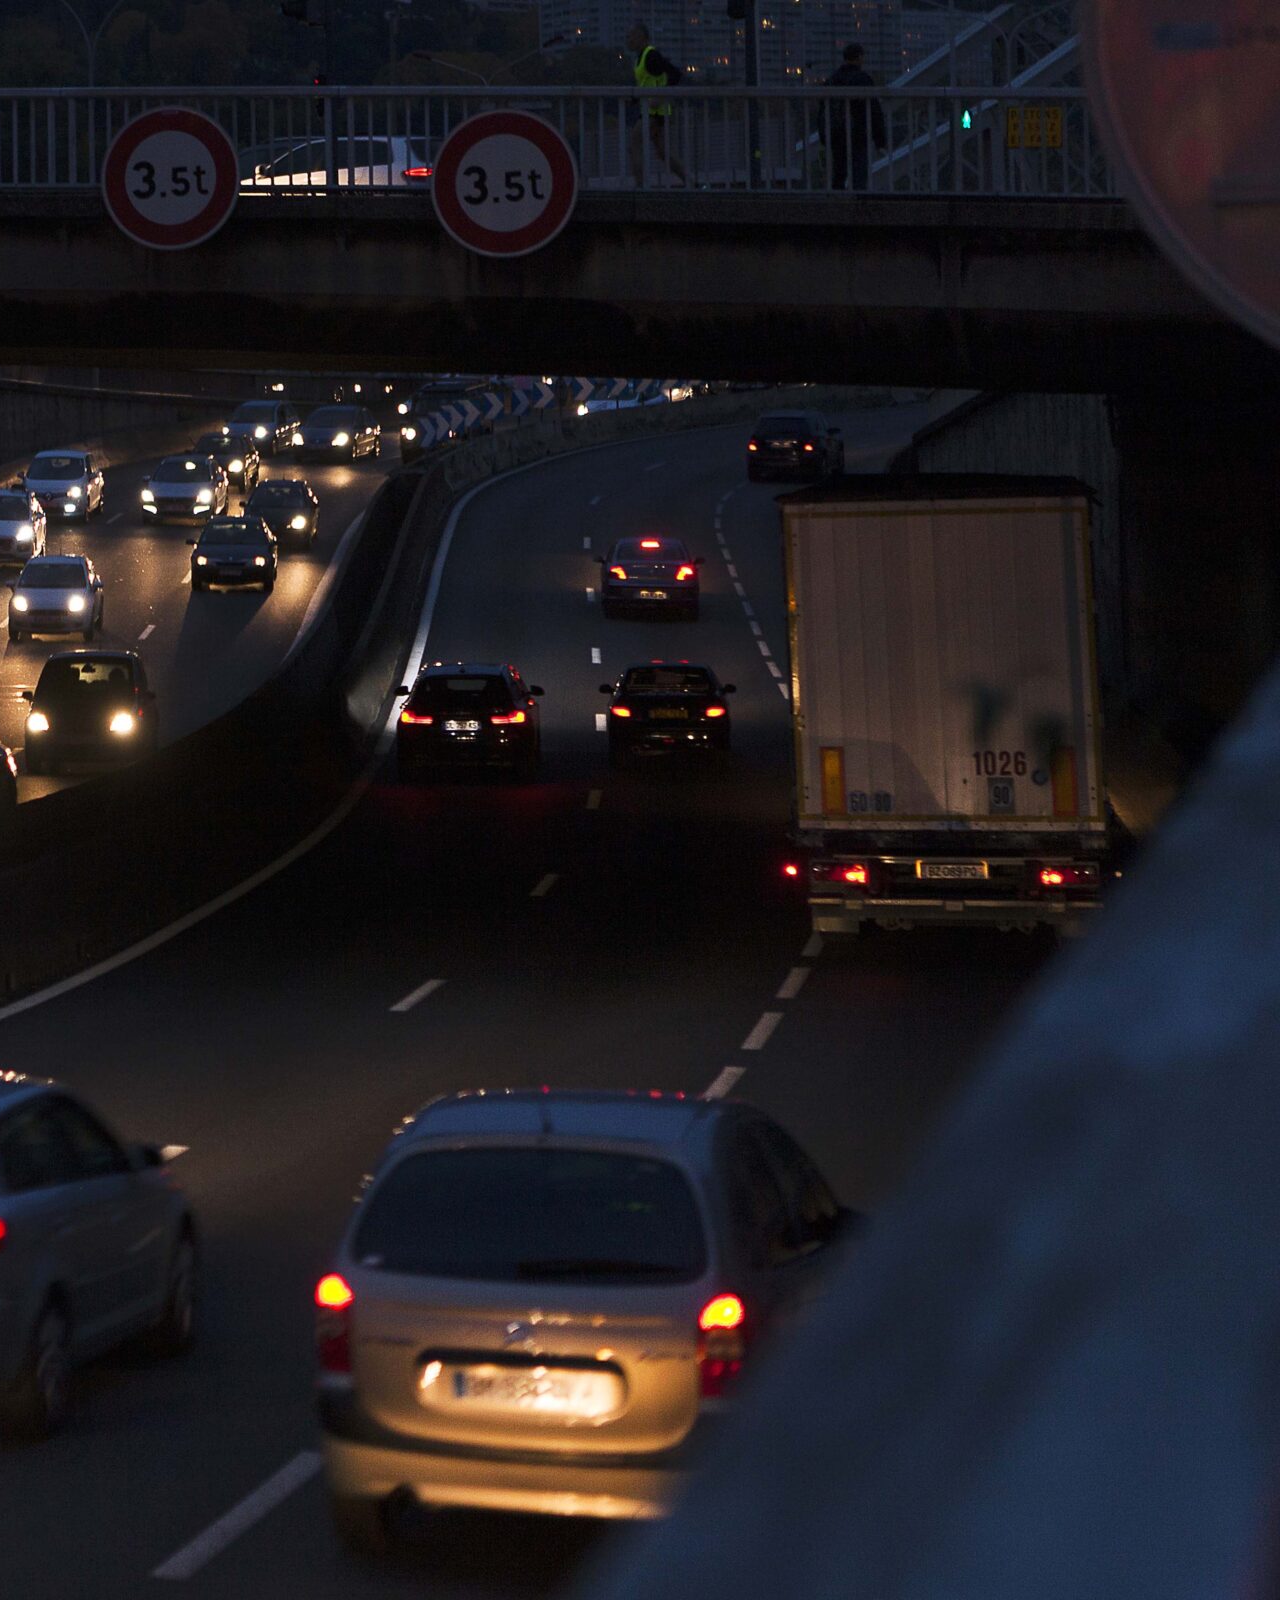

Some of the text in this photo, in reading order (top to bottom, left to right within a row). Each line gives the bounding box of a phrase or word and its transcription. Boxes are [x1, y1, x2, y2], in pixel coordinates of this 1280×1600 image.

[132, 161, 209, 199] 3.5t
[463, 165, 545, 205] 3.5t
[972, 750, 1027, 776] 1026
[993, 785, 1010, 805] 90
